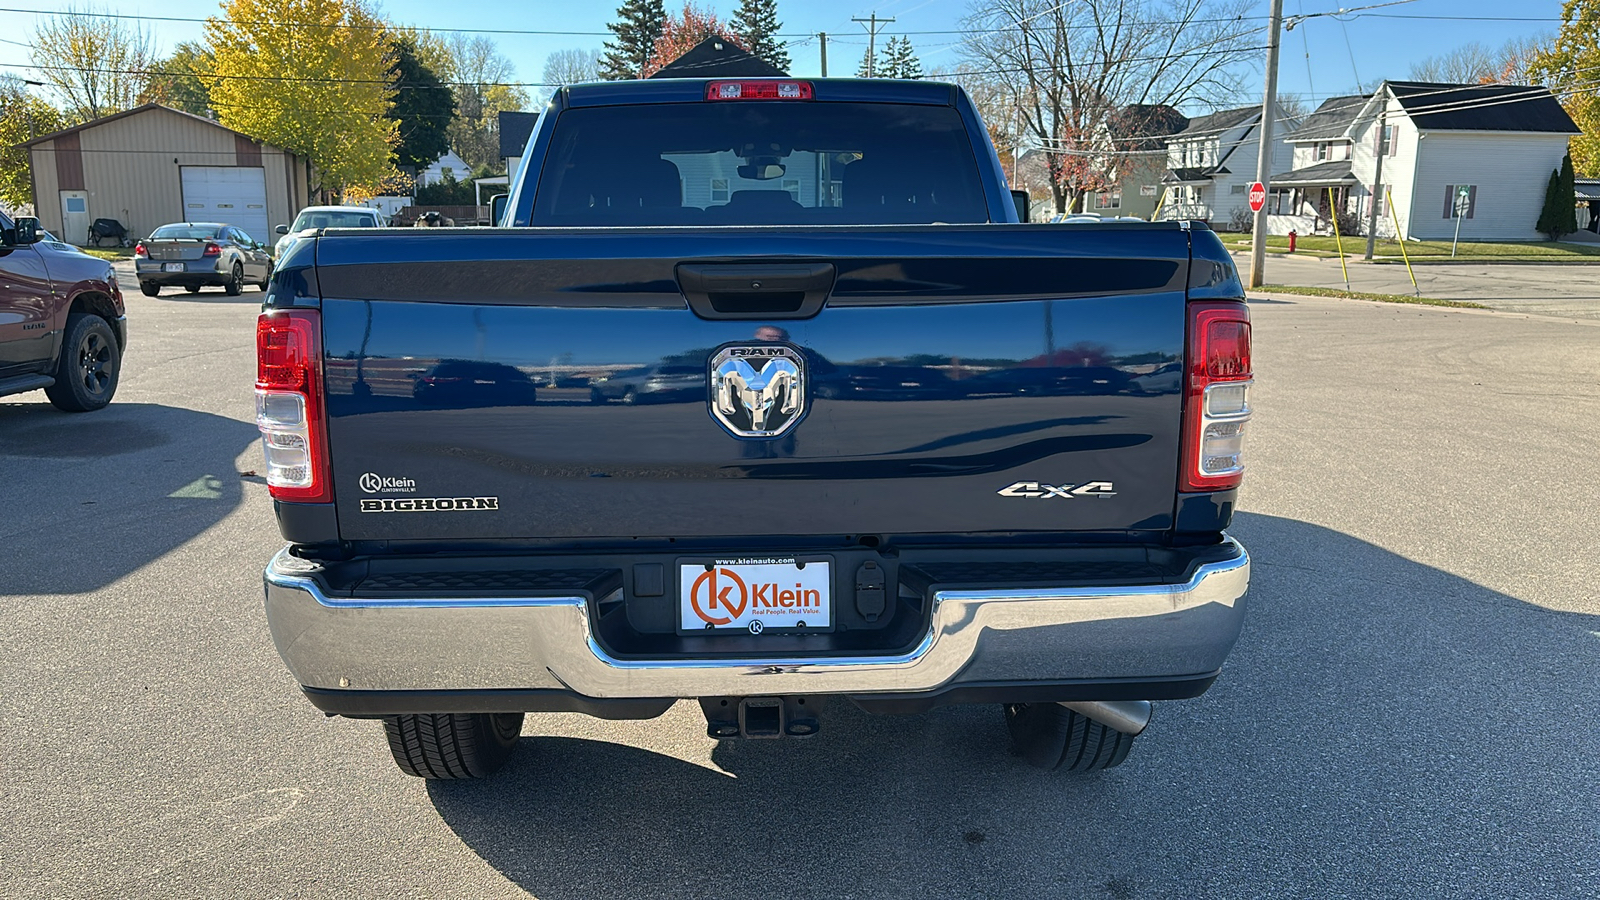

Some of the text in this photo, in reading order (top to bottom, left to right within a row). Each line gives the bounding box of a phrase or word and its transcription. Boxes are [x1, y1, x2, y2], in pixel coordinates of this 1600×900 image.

[1250, 191, 1264, 203] STOP
[730, 348, 785, 356] RAM
[382, 477, 415, 488] Klein
[360, 497, 499, 513] BIGHORN
[715, 557, 796, 565] www.kleinauto.com
[752, 583, 820, 608] Klein
